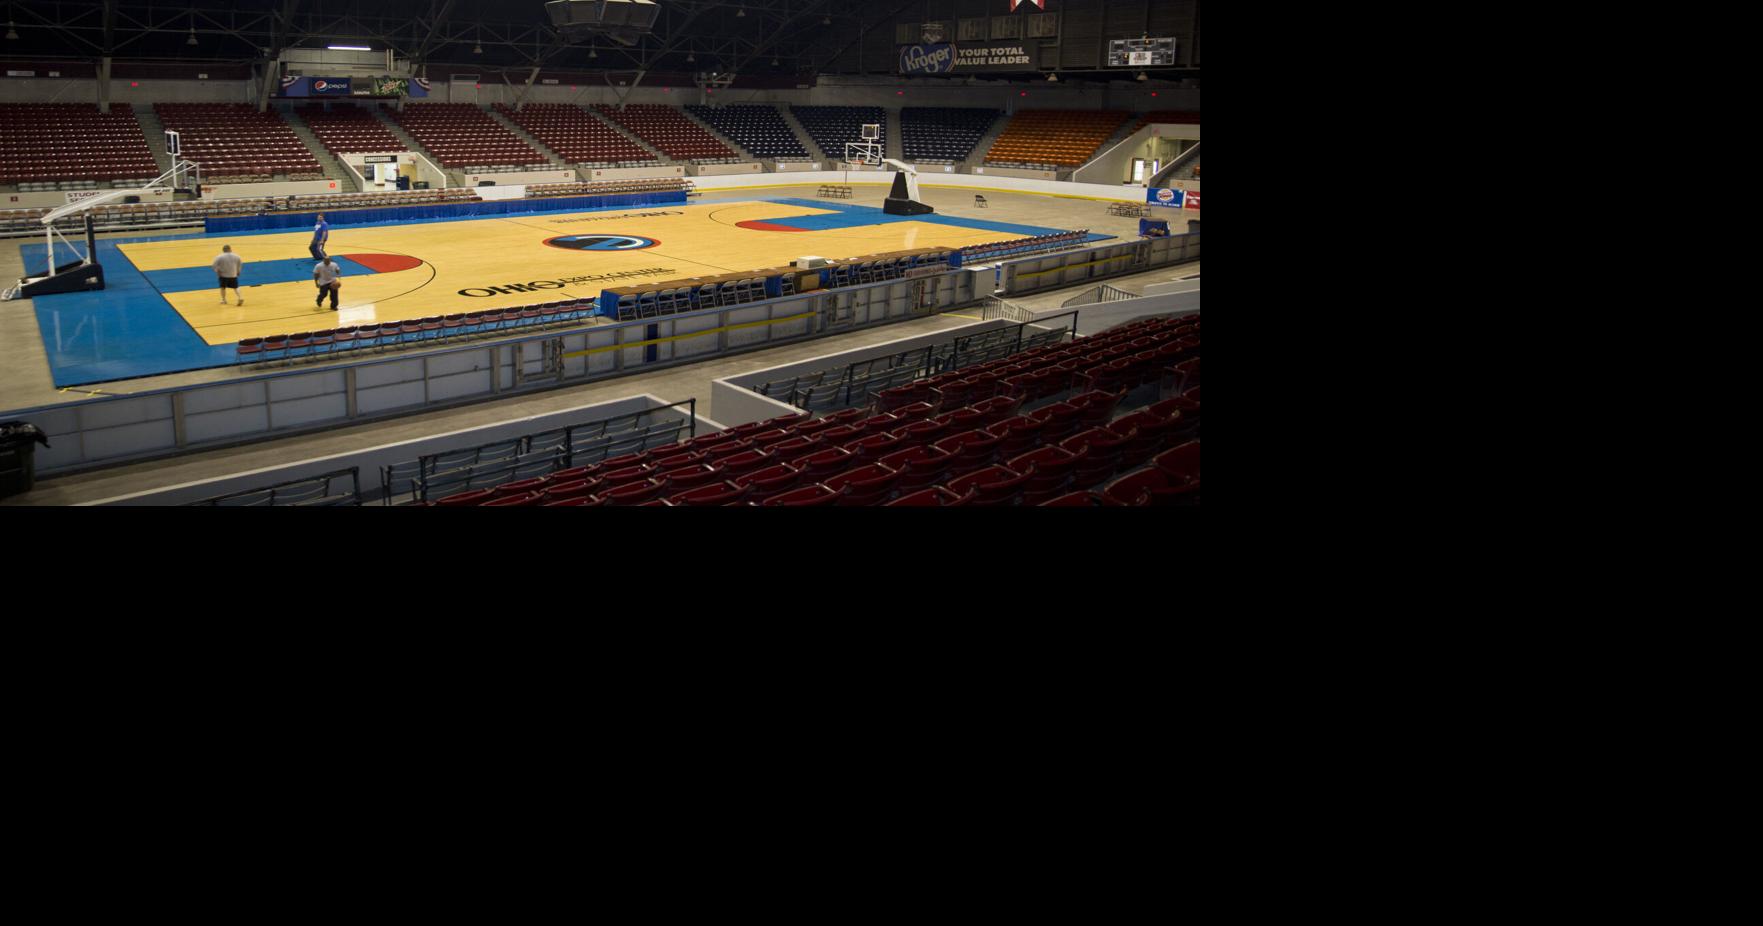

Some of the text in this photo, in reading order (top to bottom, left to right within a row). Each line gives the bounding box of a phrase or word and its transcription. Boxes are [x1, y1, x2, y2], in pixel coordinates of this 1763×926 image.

[904, 45, 950, 72] Kroger
[959, 46, 1024, 57] YOUR TOTAL
[955, 55, 1030, 66] VALUE LEADER
[457, 280, 565, 298] OHIO
